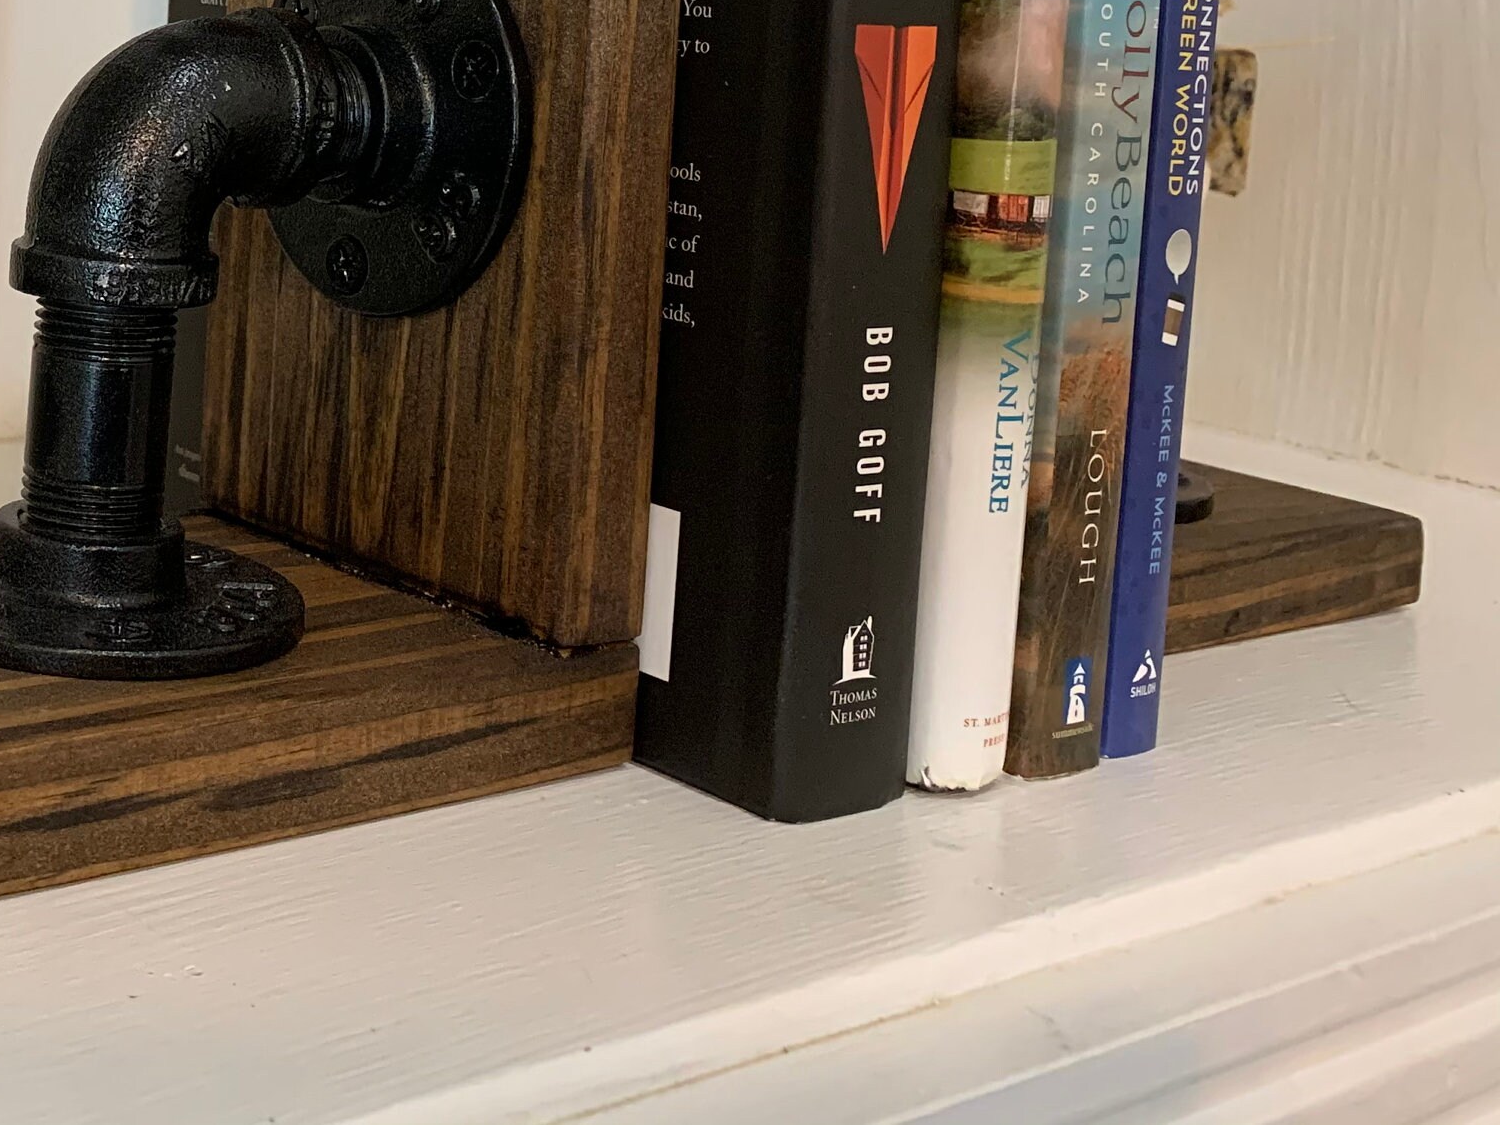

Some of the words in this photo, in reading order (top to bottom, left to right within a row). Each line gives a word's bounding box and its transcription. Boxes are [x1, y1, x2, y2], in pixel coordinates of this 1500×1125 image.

[694, 39, 710, 54] to
[1168, 84, 1192, 196] WORLD
[1077, 123, 1103, 303] CAROLINA
[1101, 130, 1142, 324] Beach
[681, 235, 700, 253] of
[665, 270, 694, 288] and
[862, 327, 893, 402] BOB
[853, 428, 887, 523] GOFF
[1156, 472, 1168, 489] &
[1079, 429, 1107, 584] LOUGH
[829, 706, 876, 725] NELSON
[830, 687, 878, 706] THOMAS
